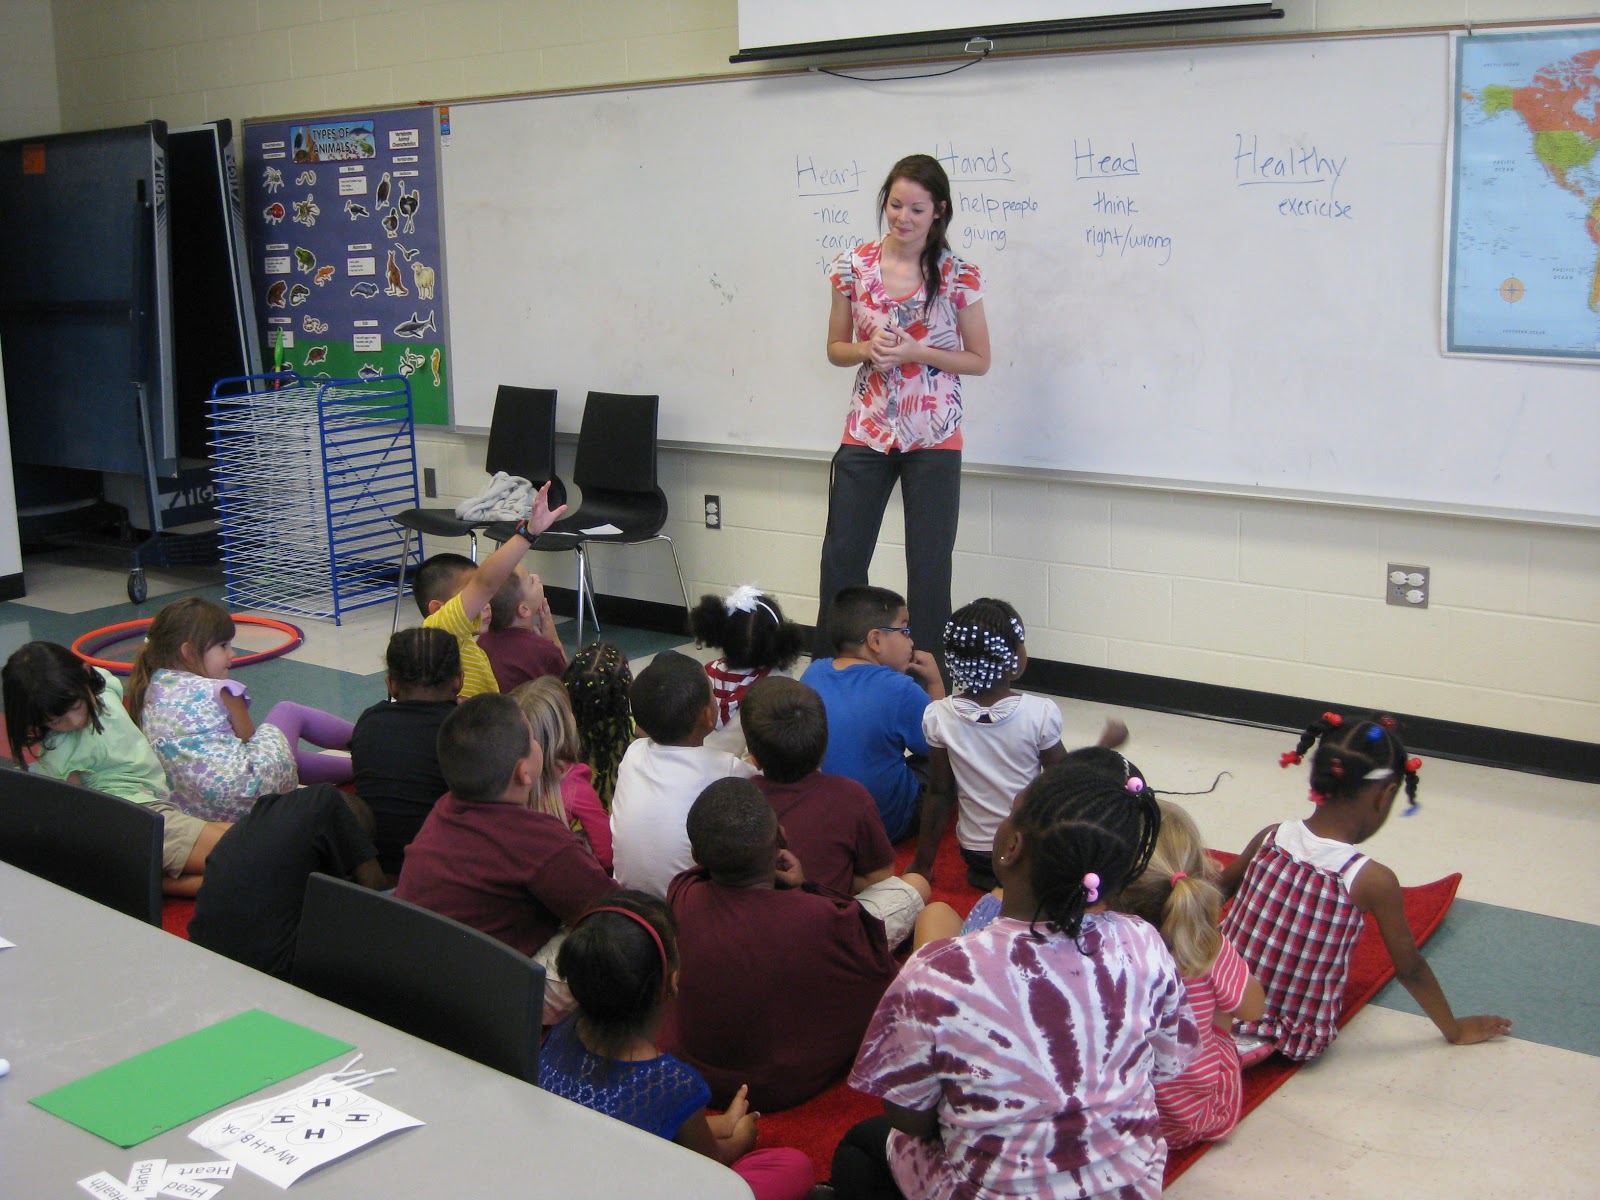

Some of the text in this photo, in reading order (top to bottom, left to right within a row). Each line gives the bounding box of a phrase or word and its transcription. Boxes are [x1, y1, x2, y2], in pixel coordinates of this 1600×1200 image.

[312, 127, 350, 140] TYPES OF
[314, 141, 351, 154] ANIMALS
[1073, 137, 1139, 175] Head
[935, 141, 1013, 176] Hands
[1234, 133, 1347, 200] Healthy
[796, 153, 867, 189] Heart
[958, 191, 1039, 222] help people
[1092, 190, 1139, 214] think
[962, 225, 1007, 251] giving
[1085, 223, 1172, 266] right/wrong
[311, 1097, 332, 1109] H
[271, 1114, 296, 1124] H
[345, 1113, 370, 1122] H
[304, 1127, 326, 1140] H
[250, 1136, 277, 1154] 4-H
[274, 1150, 299, 1166] My
[132, 1162, 154, 1193] Hands
[178, 1165, 231, 1176] Heart
[162, 1180, 208, 1199] Head
